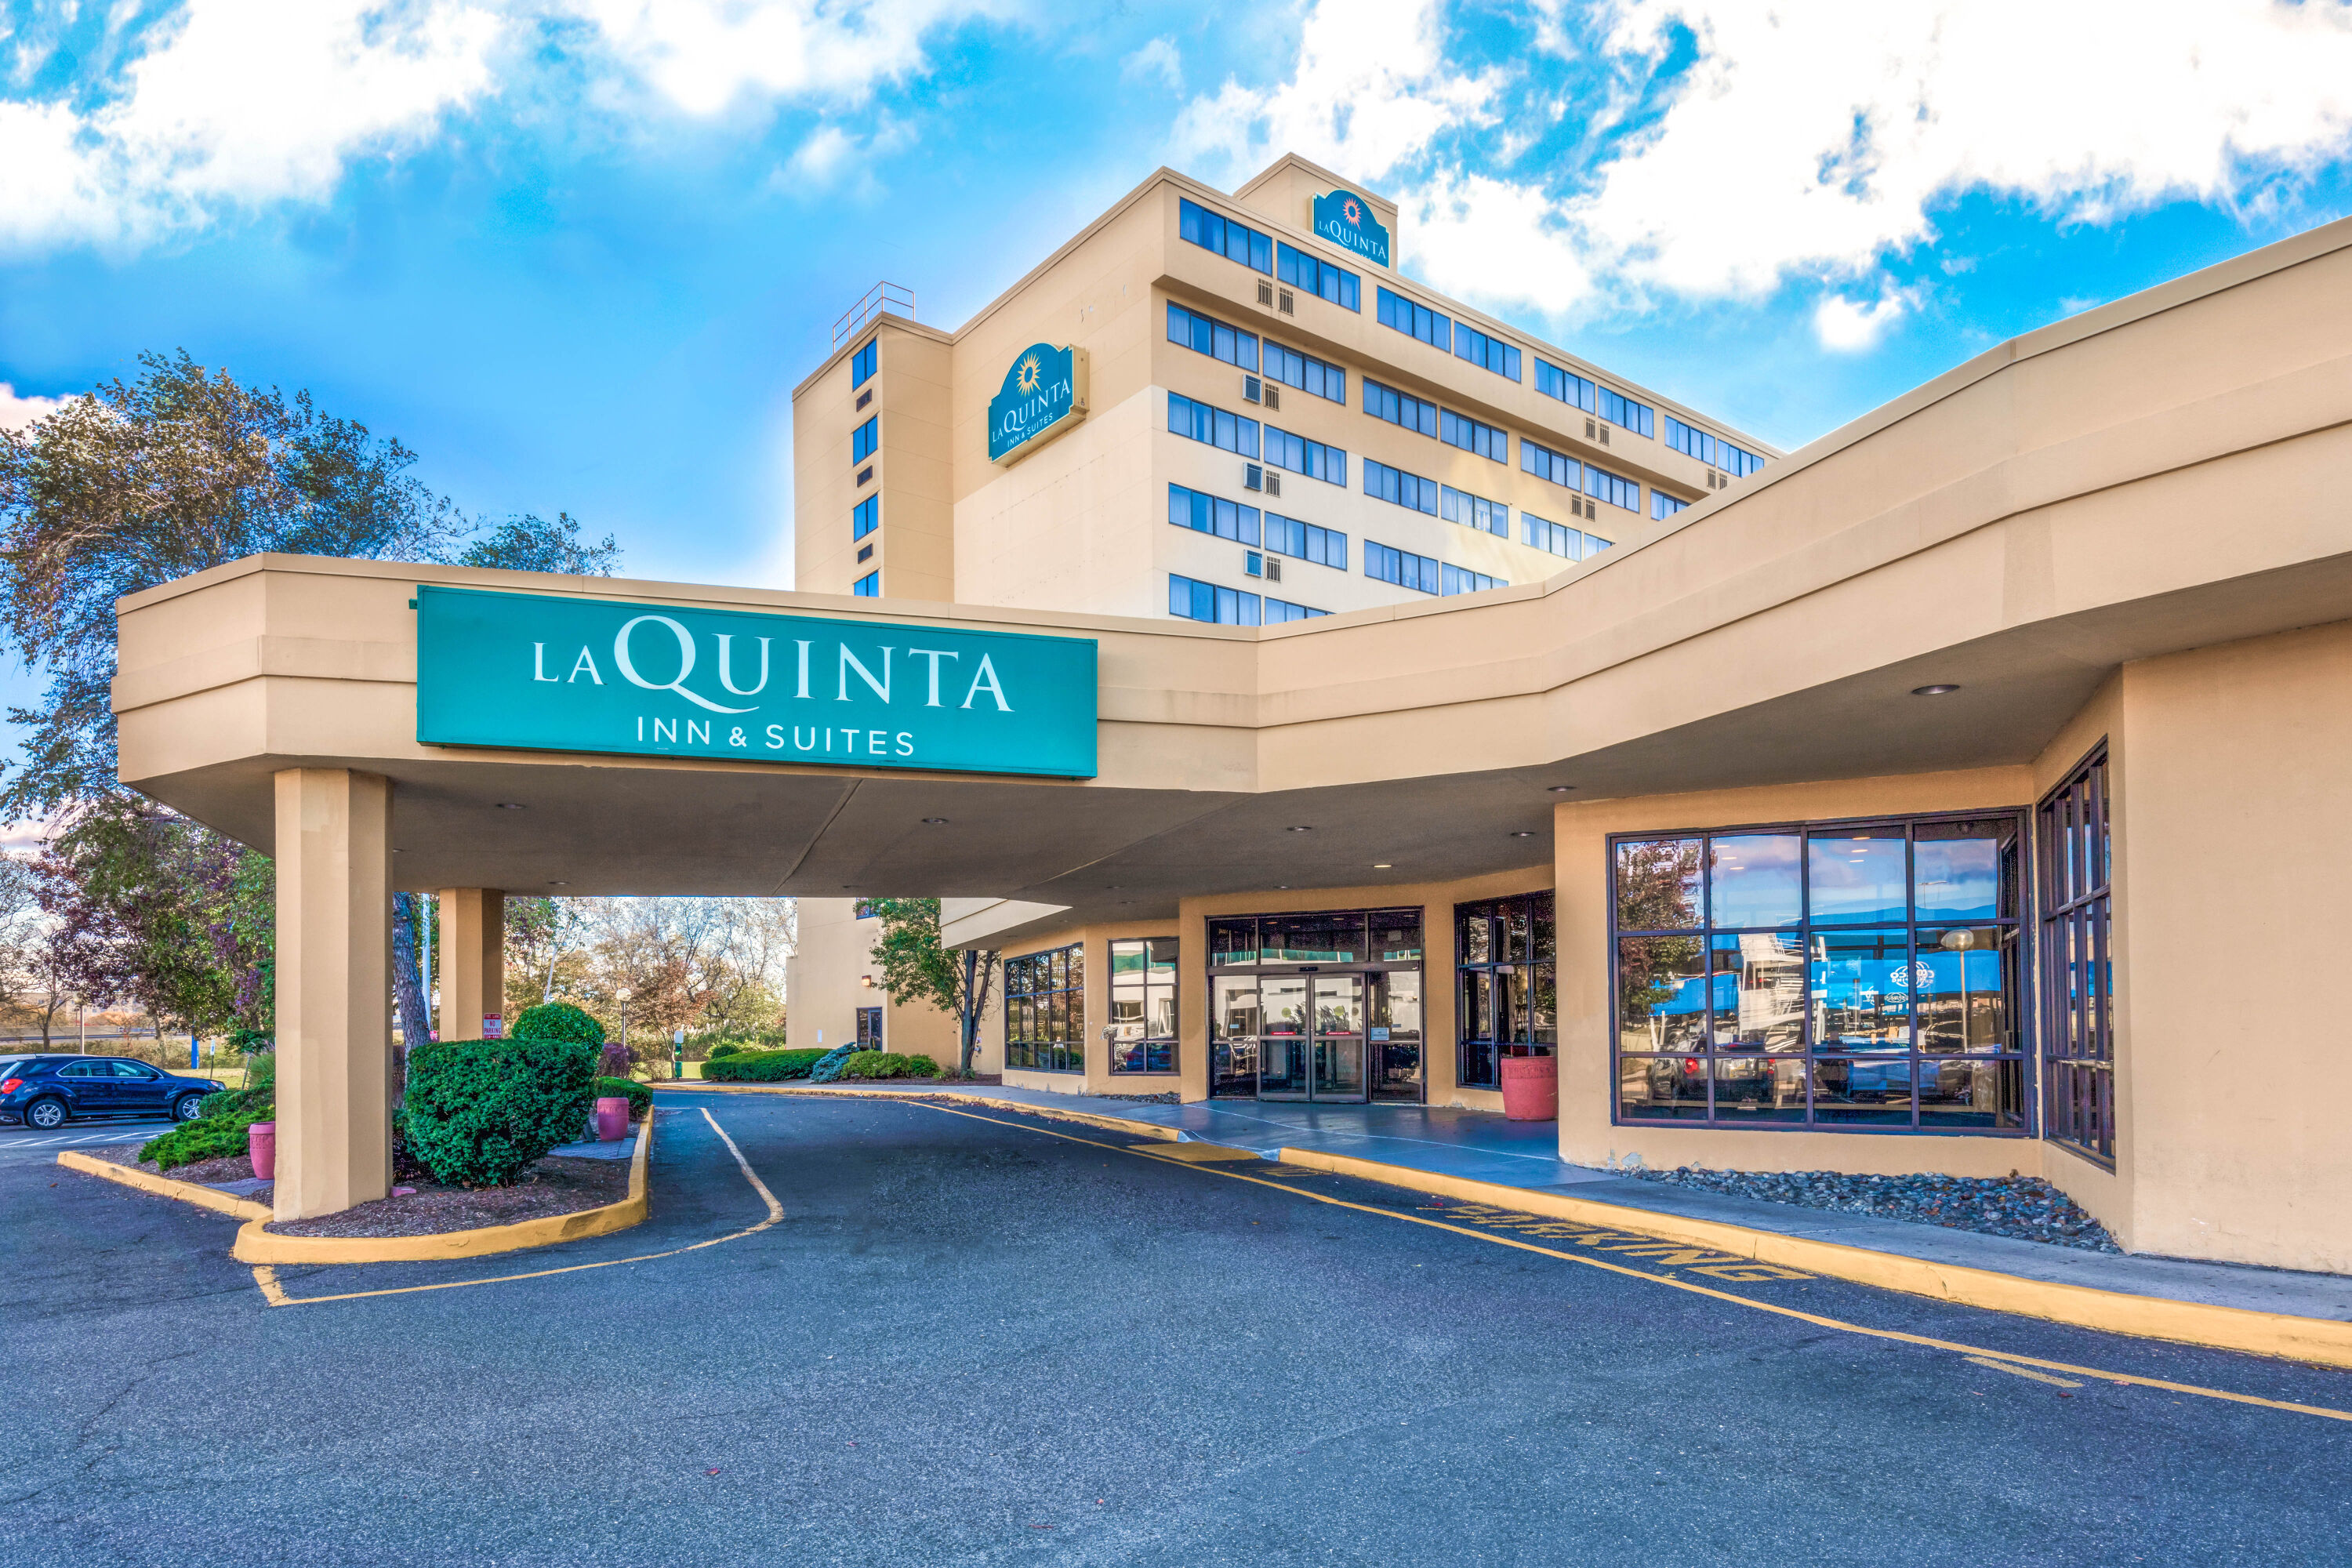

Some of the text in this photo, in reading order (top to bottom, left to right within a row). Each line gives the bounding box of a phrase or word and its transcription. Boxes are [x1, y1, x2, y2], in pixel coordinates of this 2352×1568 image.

[1319, 220, 1330, 233] LA
[1330, 220, 1386, 260] QUINTA
[992, 377, 1071, 443] LA QUINTA
[1007, 434, 1020, 448] INN
[1027, 412, 1053, 435] SUITES
[532, 615, 1014, 714] LA QUINTA
[637, 716, 914, 757] INN & SUITES
[1416, 1205, 1817, 1281] PARKING
